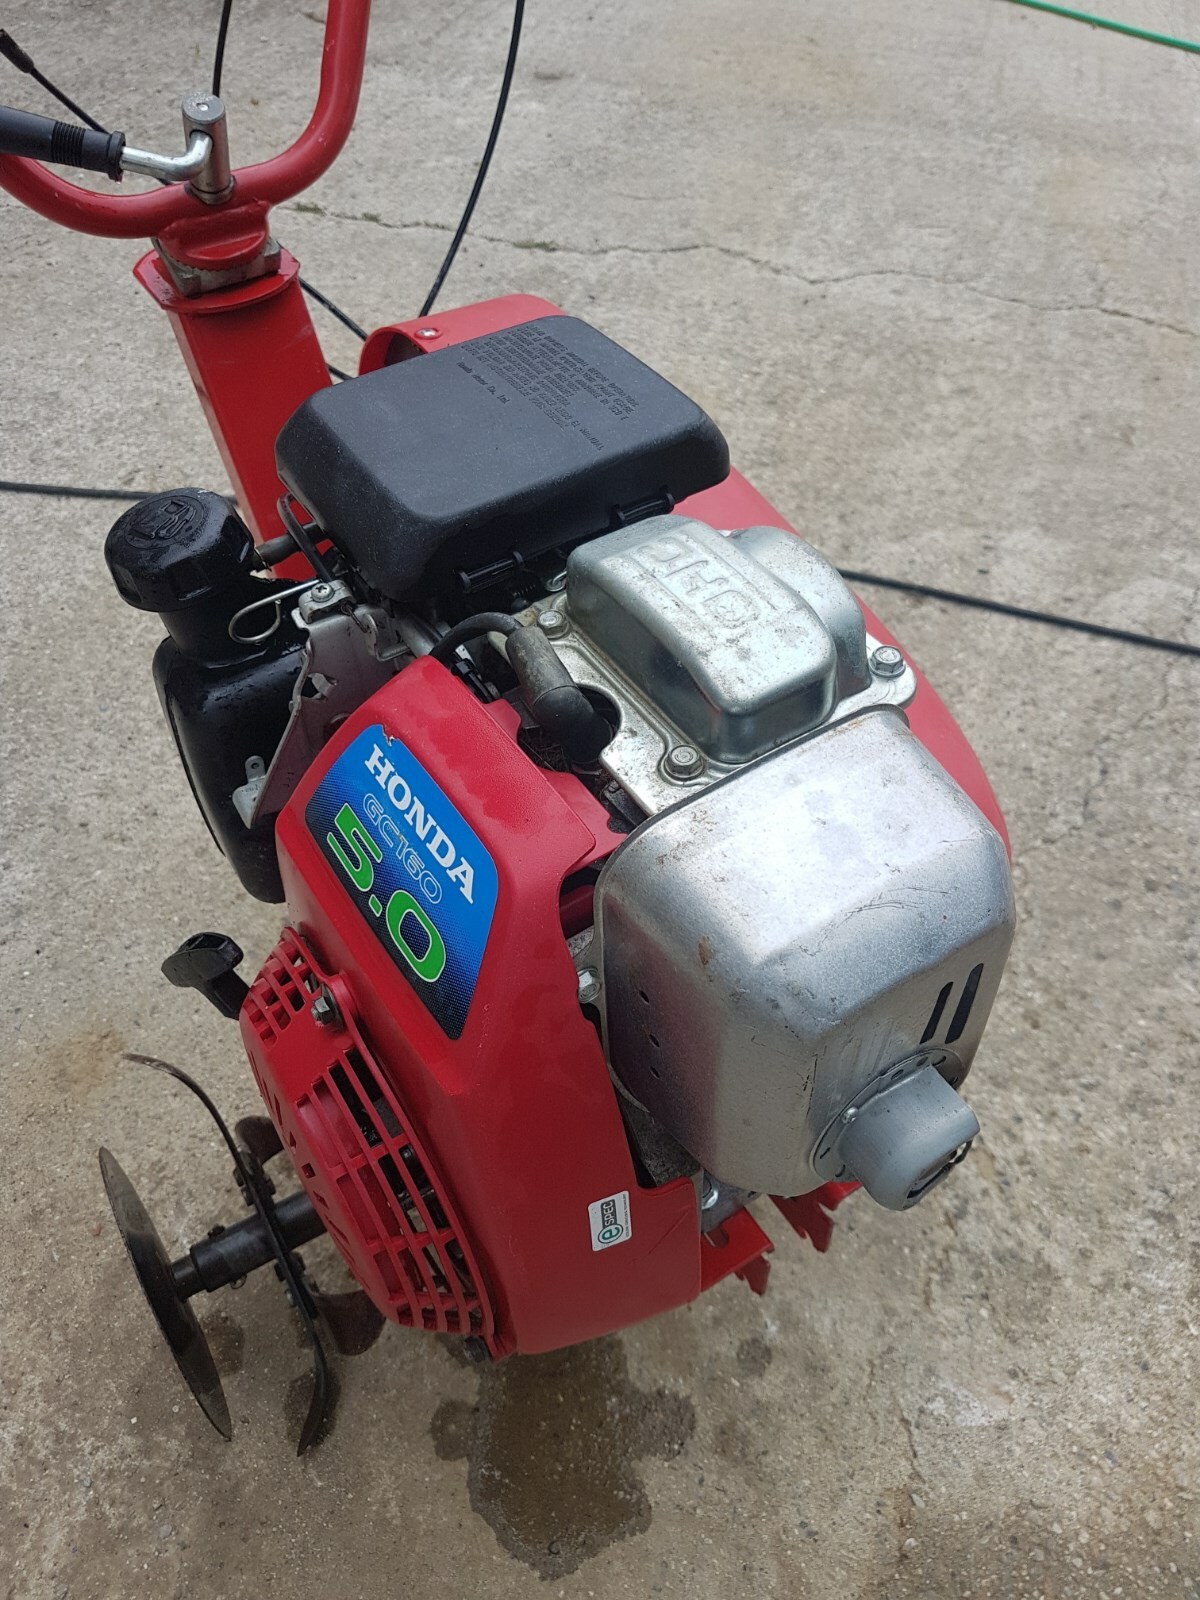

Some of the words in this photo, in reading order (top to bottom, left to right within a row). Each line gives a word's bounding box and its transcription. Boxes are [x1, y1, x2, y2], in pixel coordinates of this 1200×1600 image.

[634, 536, 755, 626] OHC
[362, 792, 443, 905] GC160
[364, 743, 474, 904] HONDA
[326, 801, 446, 983] 5.0
[602, 1201, 615, 1226] SPEC
